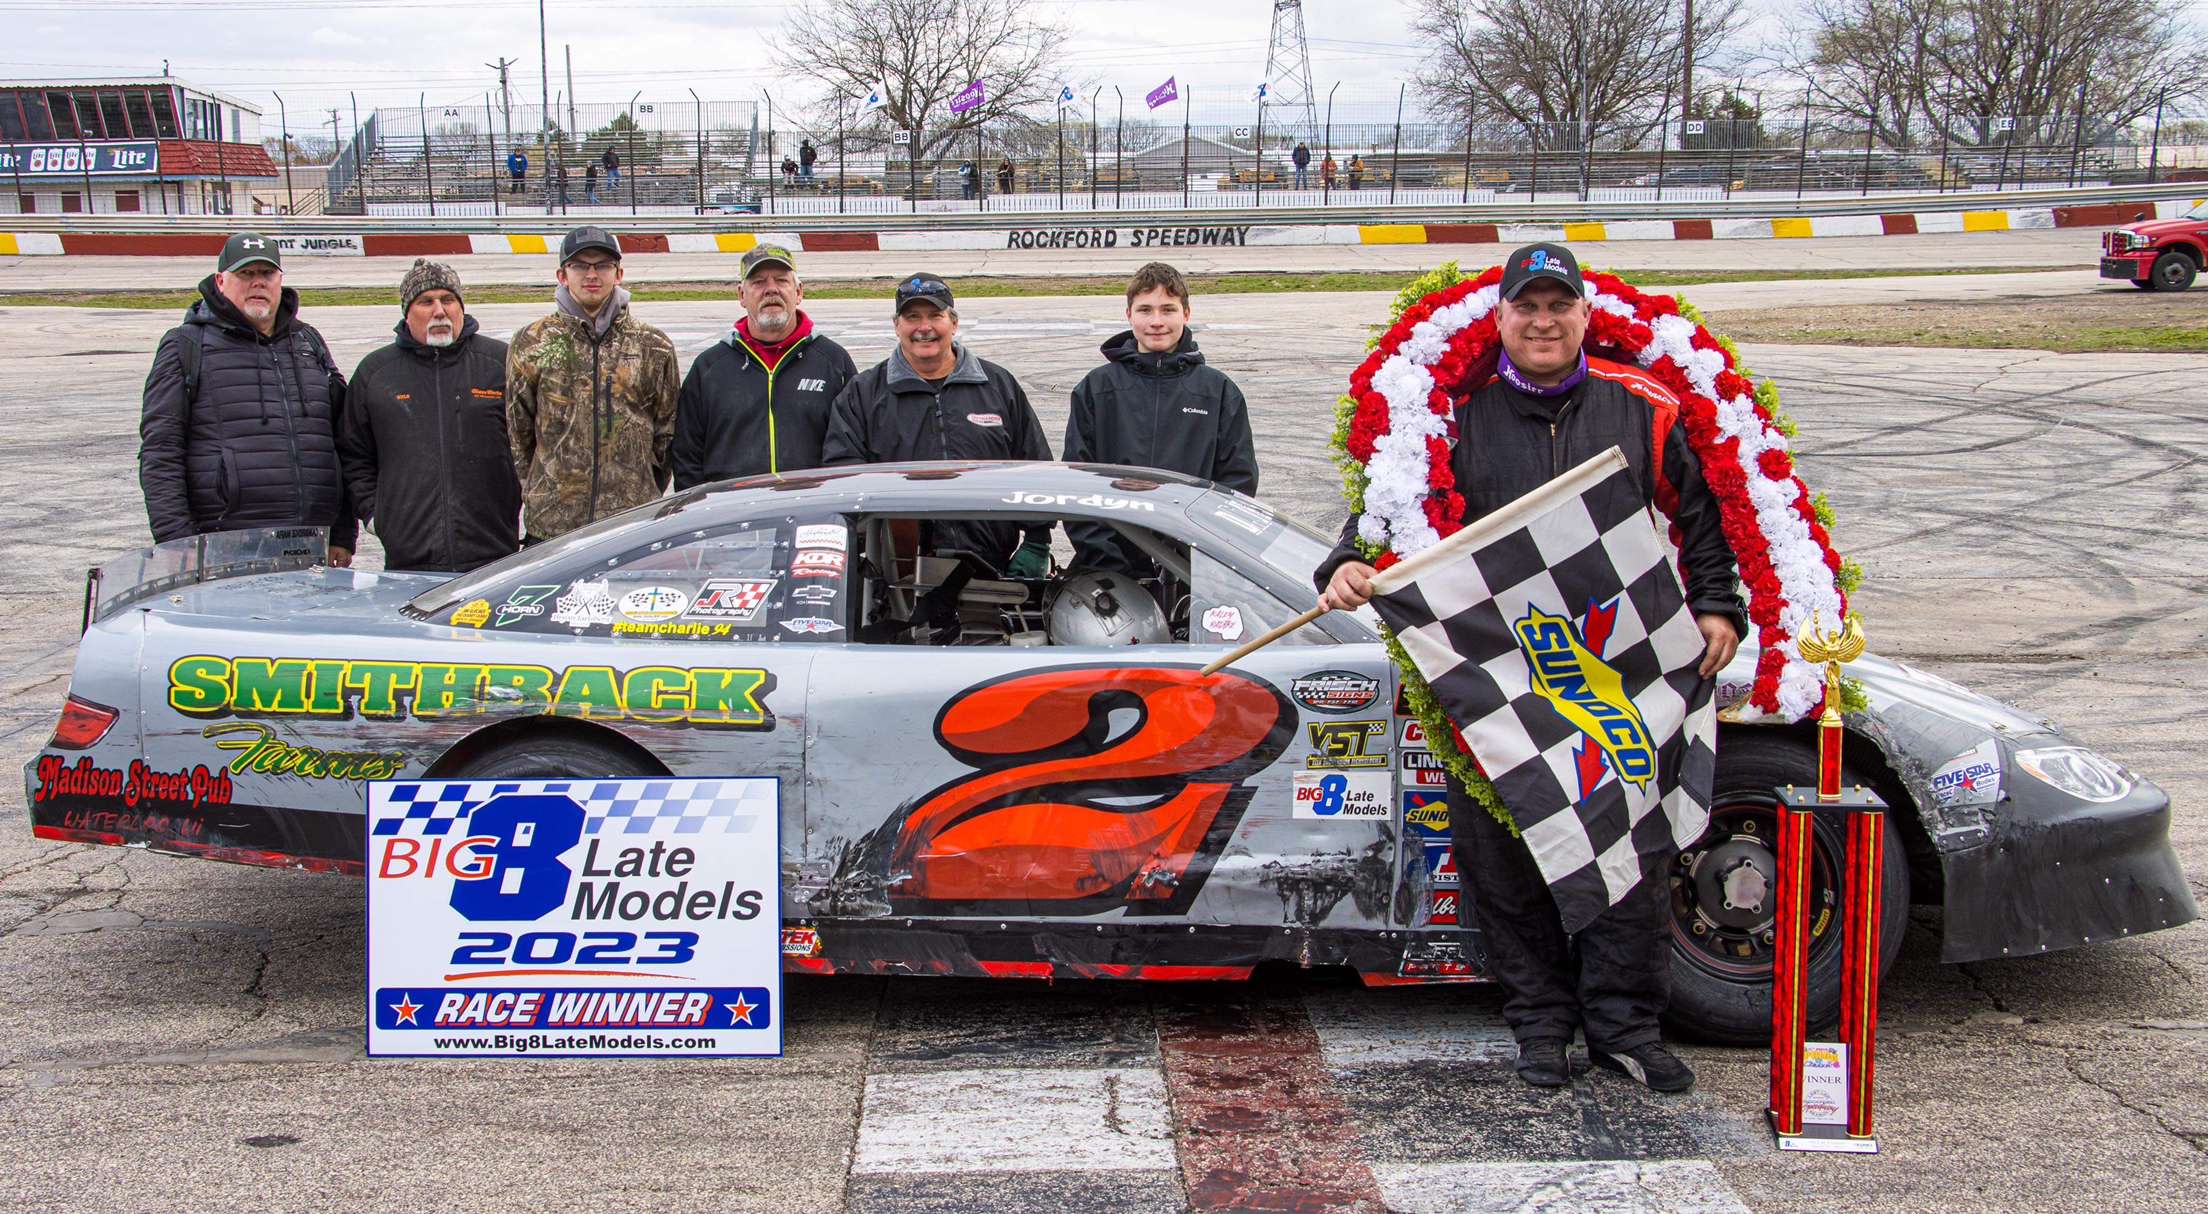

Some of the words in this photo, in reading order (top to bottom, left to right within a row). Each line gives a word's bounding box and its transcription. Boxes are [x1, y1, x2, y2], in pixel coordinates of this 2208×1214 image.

[444, 109, 459, 117] AA
[640, 105, 653, 113] BB
[1235, 128, 1248, 136] CC
[1688, 123, 1702, 132] DD
[895, 132, 908, 141] BB
[0, 153, 21, 168] ite
[112, 150, 146, 169] Lite
[1007, 230, 1118, 249] ROCKFORD
[1130, 226, 1251, 247] SPEEDWAY
[1543, 263, 1568, 275] Models
[1545, 256, 1560, 266] Late
[797, 378, 826, 392] NIKE
[1001, 490, 1155, 512] Jordyn
[501, 606, 540, 614] HORN
[689, 607, 752, 617] Photography
[612, 620, 711, 636] #teamcharlie
[168, 655, 772, 728] SMITHBACK
[1293, 680, 1378, 692] FRISCH
[1521, 621, 1654, 777] SUNOCO
[1308, 720, 1387, 758] VST
[35, 755, 123, 802] Madison
[125, 759, 190, 807] Street
[190, 764, 233, 808] Pub
[1933, 769, 1963, 790] FIVE
[1965, 762, 1994, 778] STAR
[1296, 787, 1323, 801] BIG
[1312, 774, 1348, 816] 8
[1345, 790, 1374, 802] Late
[1342, 803, 1388, 816] Models
[378, 836, 500, 880] BIG
[449, 793, 588, 921] 8
[581, 838, 696, 878] Late
[571, 881, 763, 921] Models
[449, 931, 700, 965] 2023
[434, 991, 546, 1028] RACE
[547, 991, 714, 1028] WINNER
[434, 1034, 716, 1052] www.Big8LateModels.com
[1801, 1075, 1842, 1084] INNER
